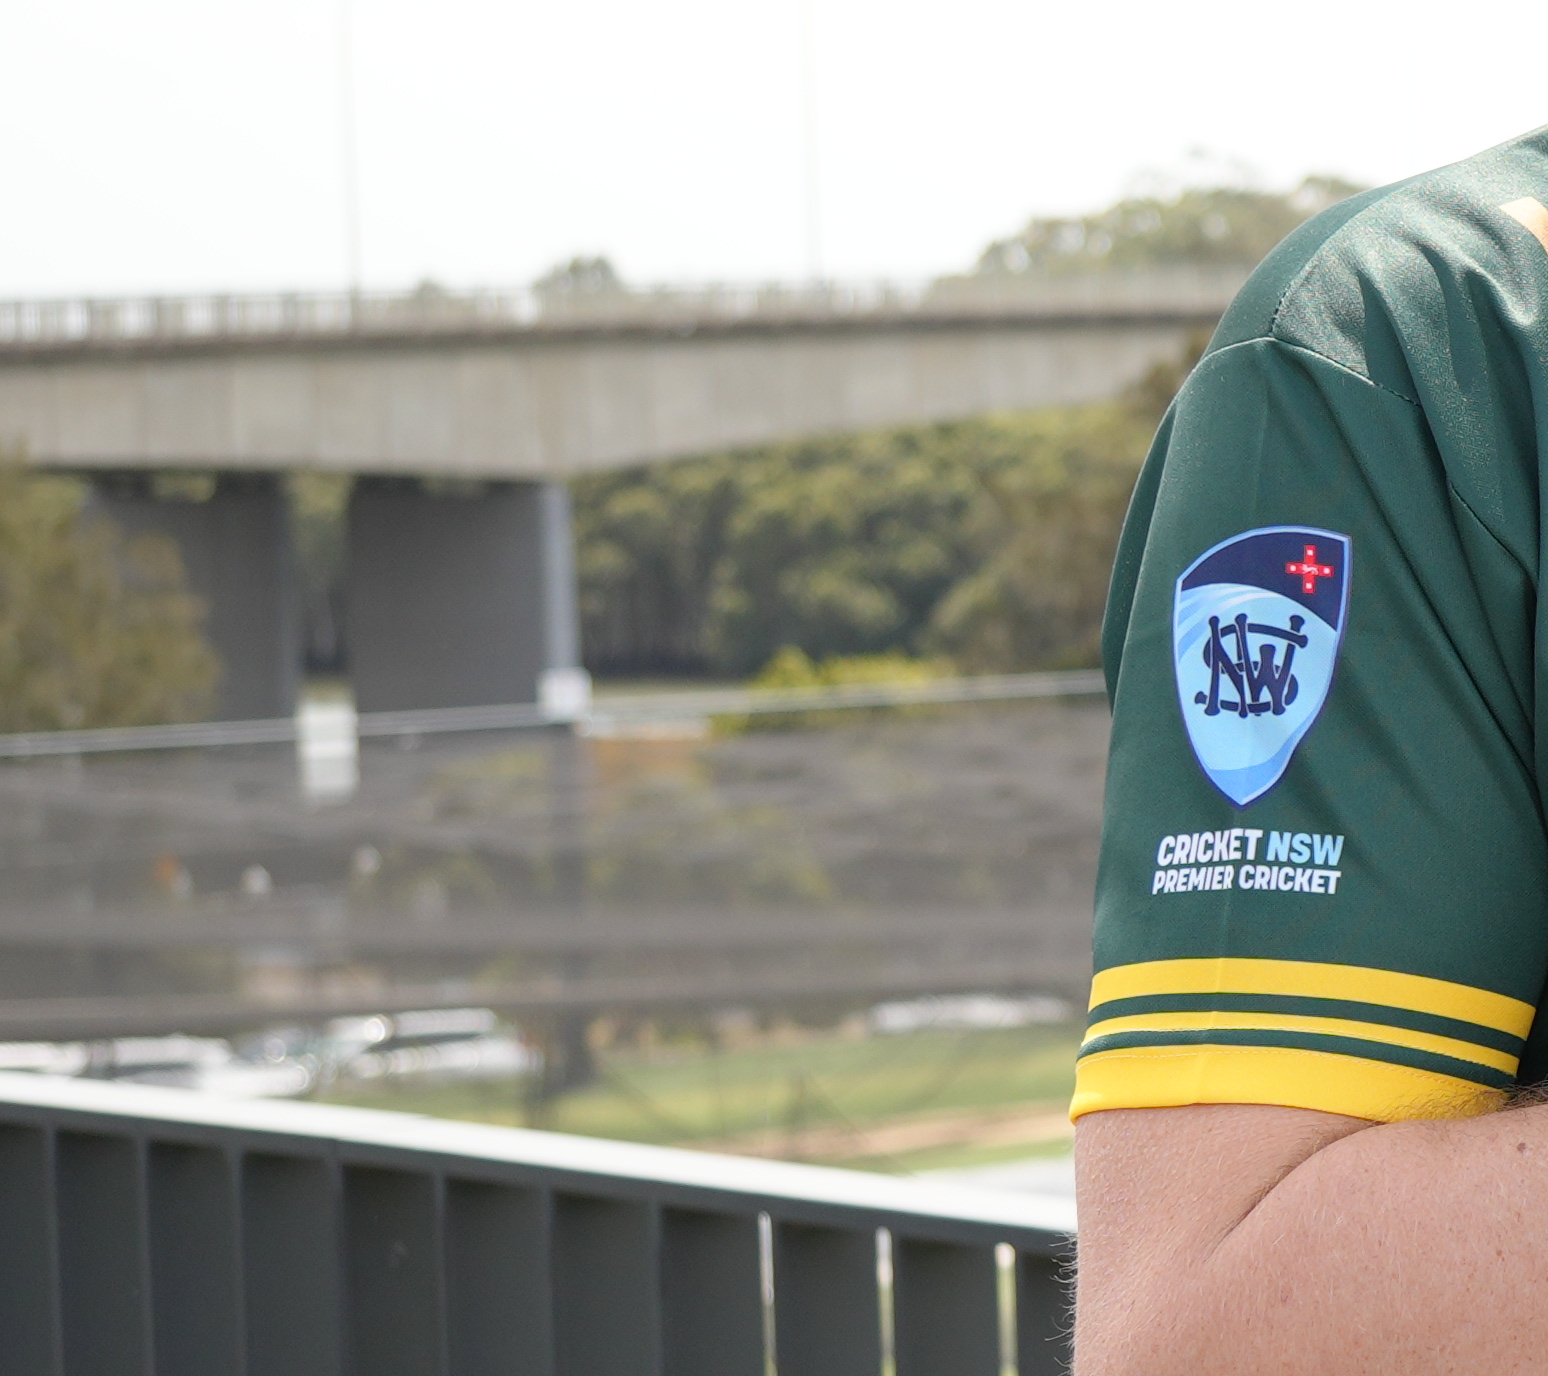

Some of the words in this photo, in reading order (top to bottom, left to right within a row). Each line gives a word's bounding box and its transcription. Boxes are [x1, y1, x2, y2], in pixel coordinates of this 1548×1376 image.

[1157, 828, 1263, 866] CRICKET
[1266, 830, 1345, 866] NSW
[1152, 865, 1235, 895] PREMIER
[1238, 864, 1342, 895] CRICKET
